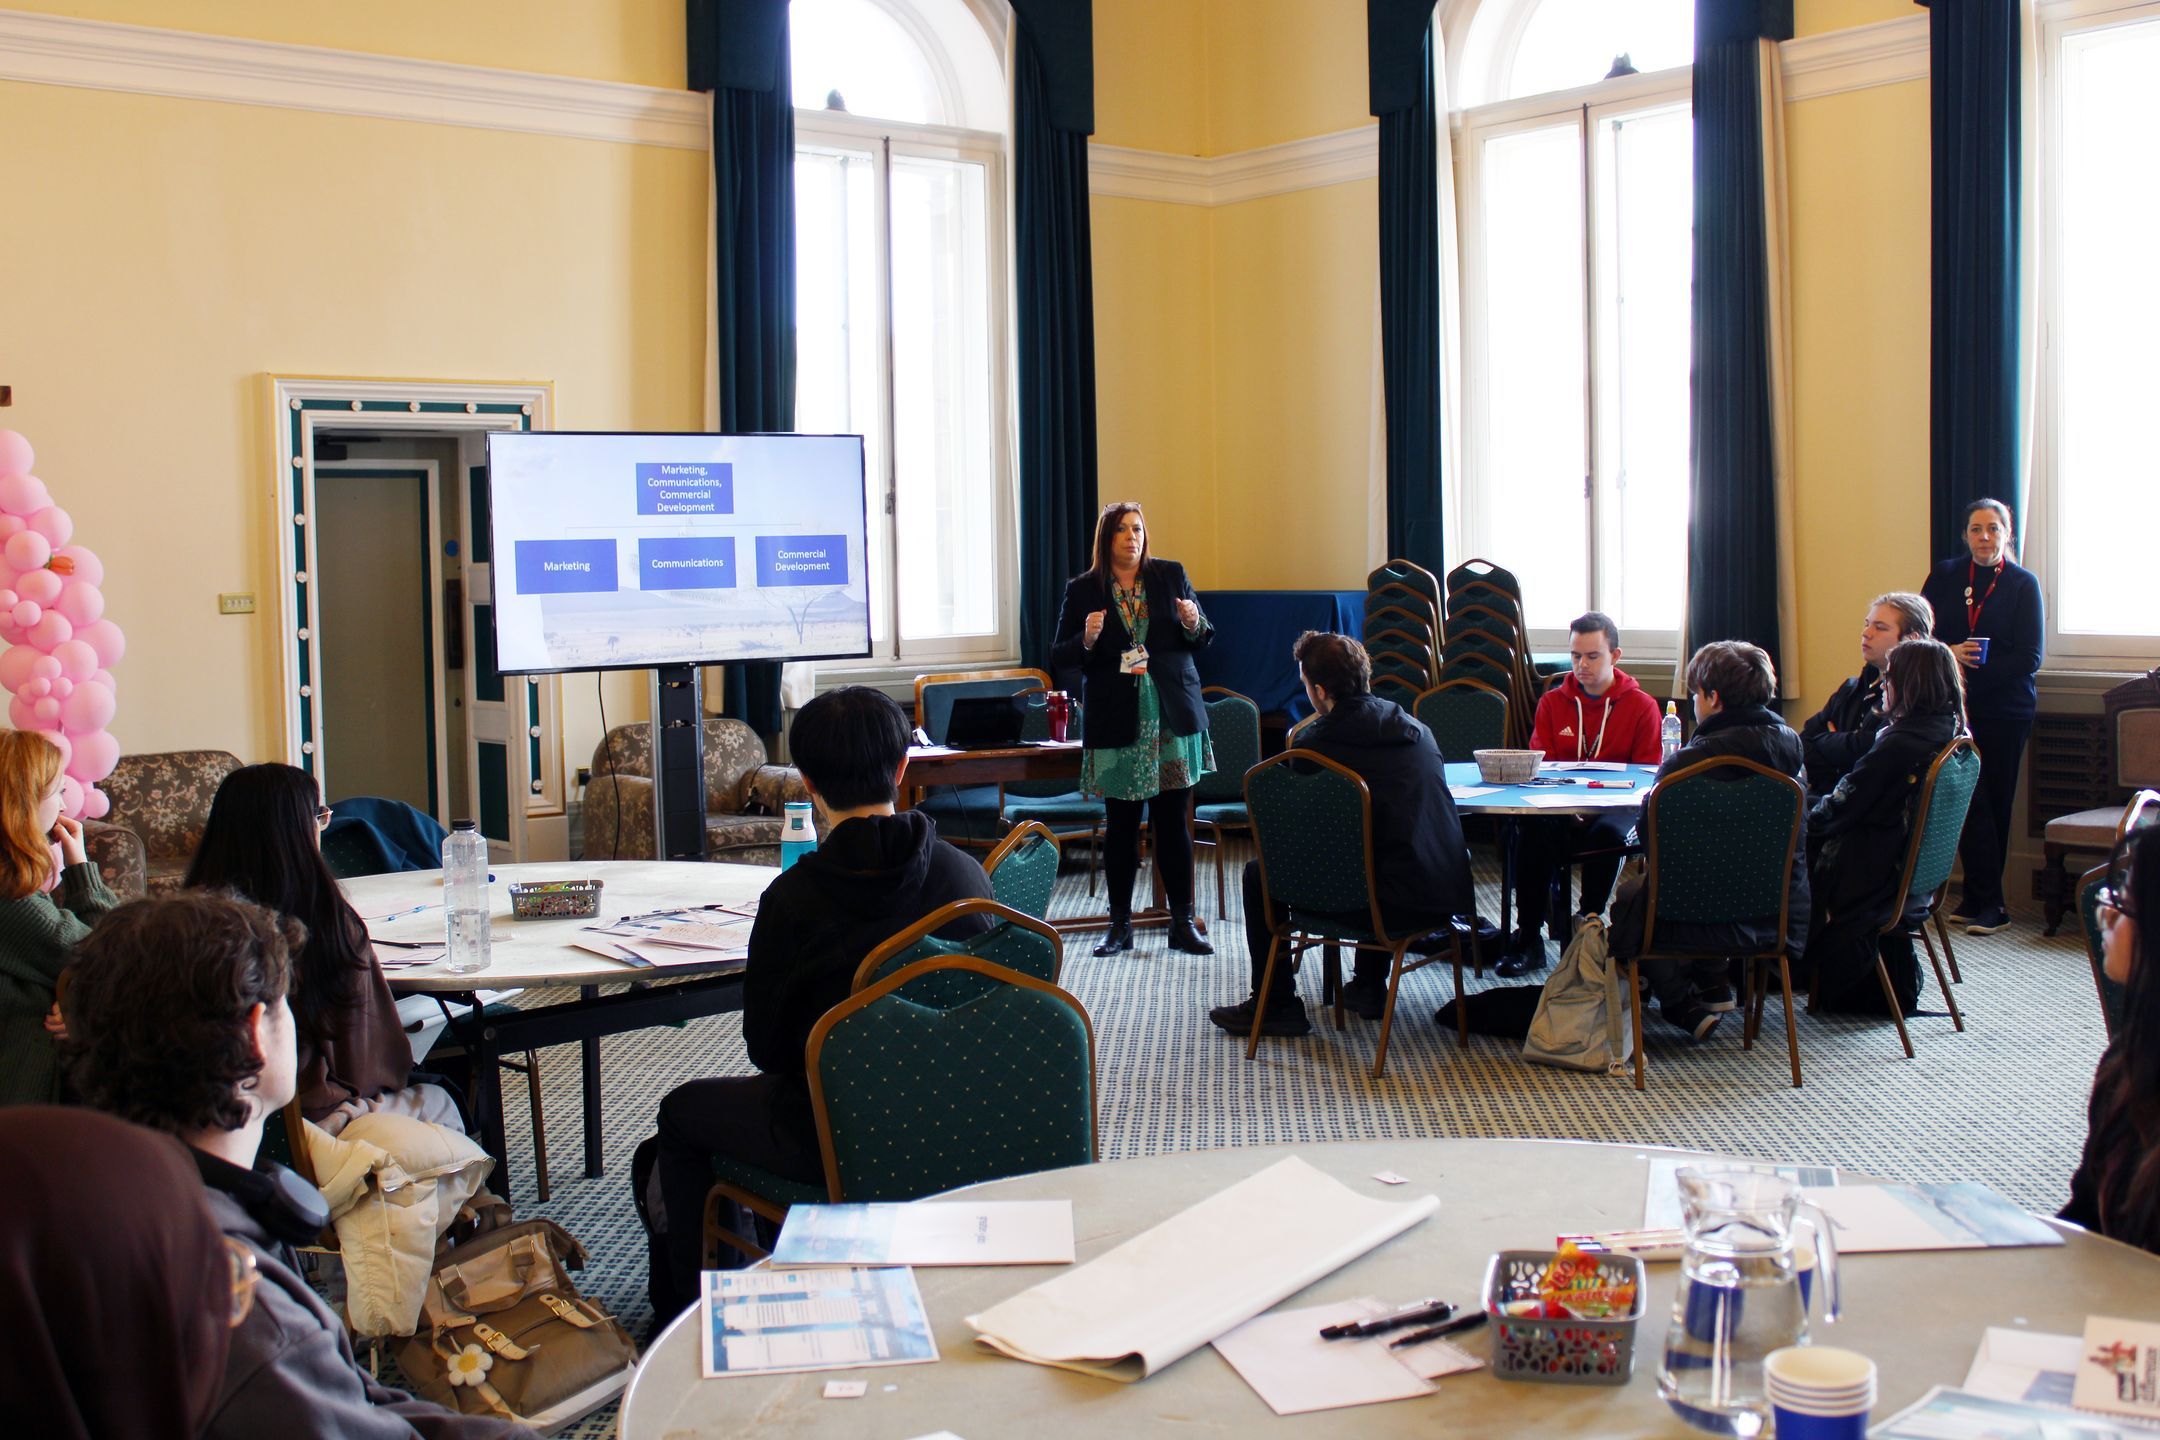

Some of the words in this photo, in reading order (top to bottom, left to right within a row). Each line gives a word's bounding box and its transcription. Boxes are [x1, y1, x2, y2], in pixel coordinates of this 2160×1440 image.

[661, 465, 708, 476] Marketing,
[647, 478, 722, 488] Communications,
[660, 490, 711, 499] Commercial
[657, 502, 715, 513] Development
[778, 549, 826, 559] Commercial
[544, 561, 590, 573] Marketing
[652, 558, 724, 569] Communications
[775, 562, 830, 573] Development
